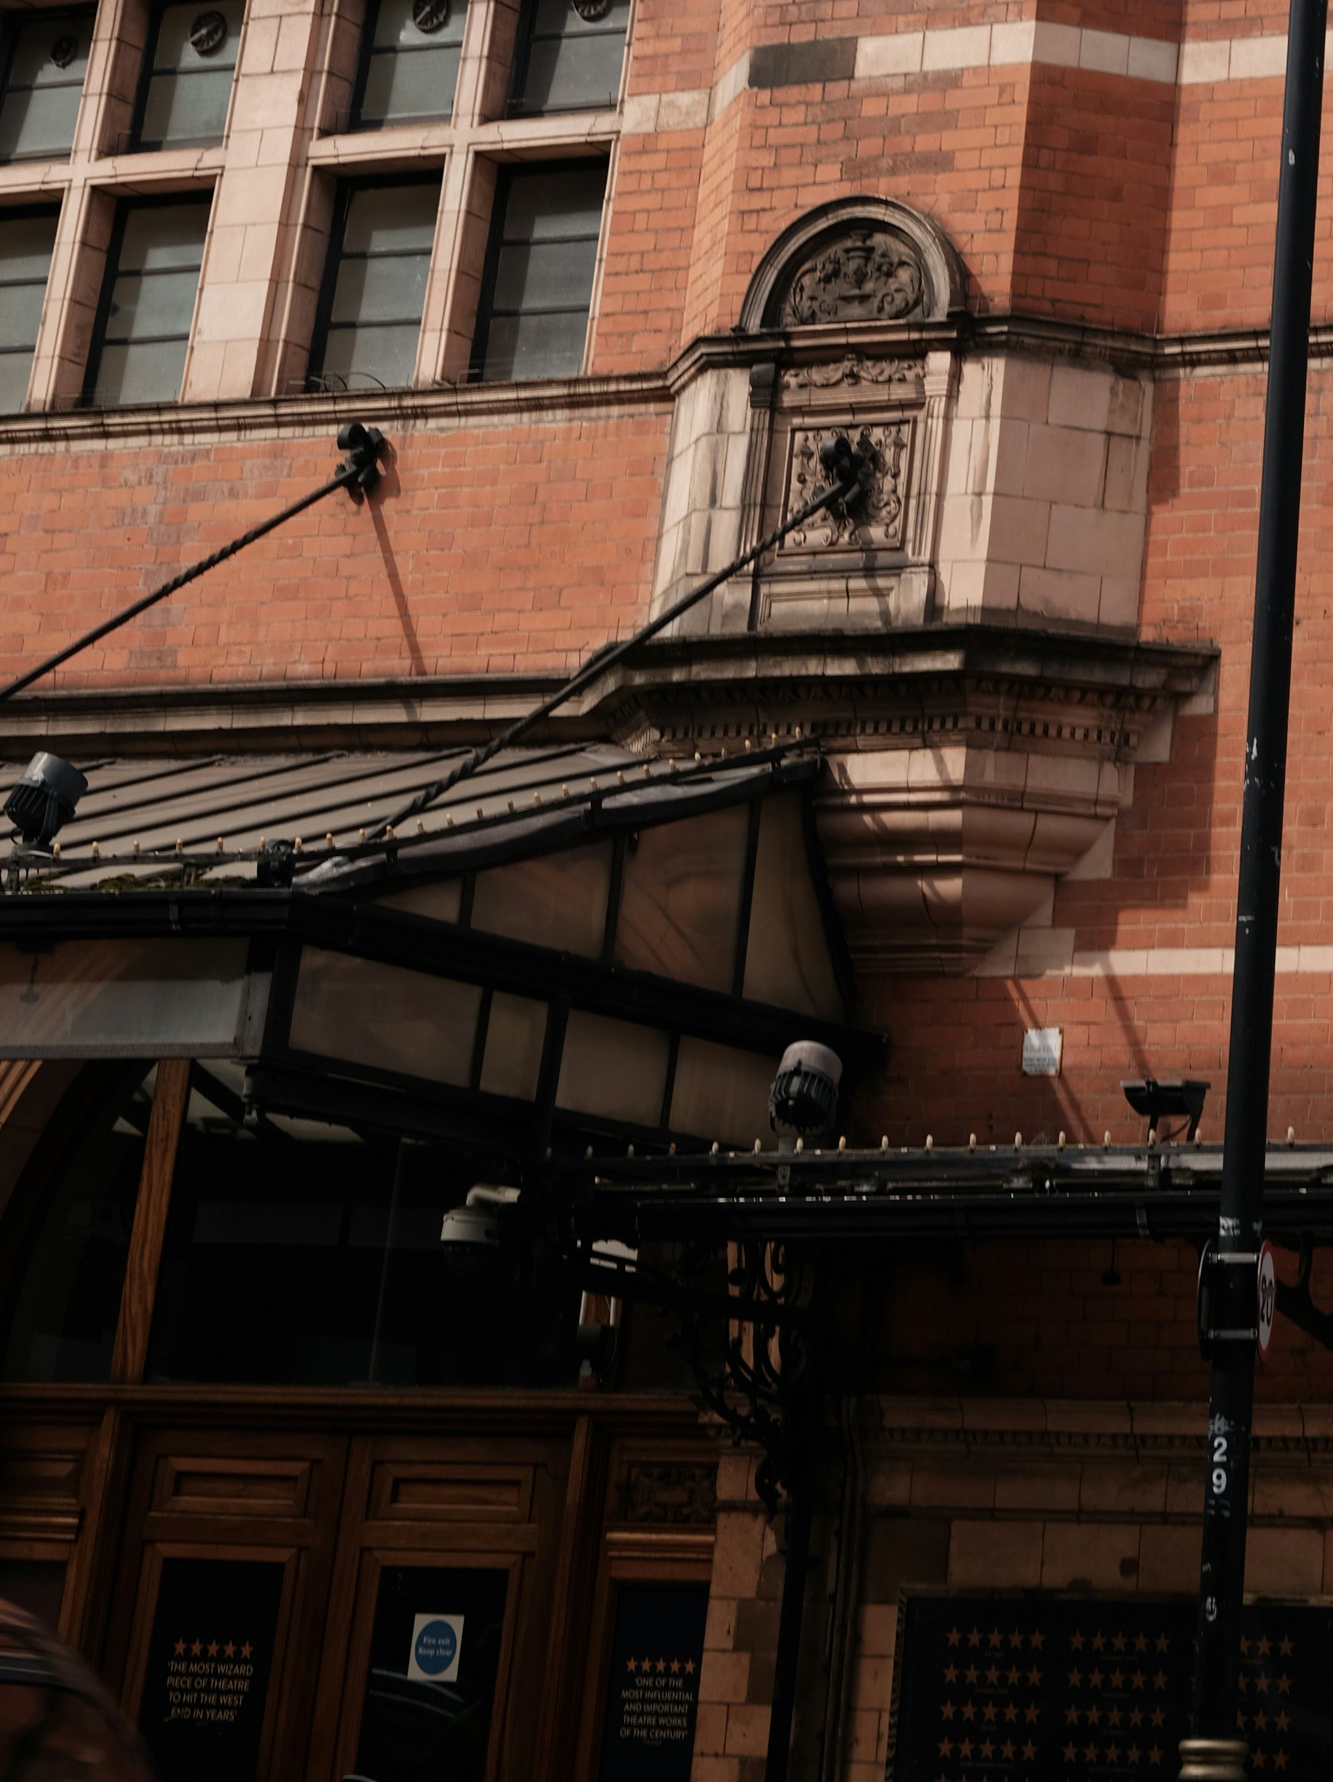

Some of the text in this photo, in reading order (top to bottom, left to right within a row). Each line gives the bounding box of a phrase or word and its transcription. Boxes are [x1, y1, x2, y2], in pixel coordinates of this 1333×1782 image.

[189, 1661, 215, 1675] MOST
[217, 1662, 254, 1677] WIZARD
[166, 1676, 250, 1693] PIECE OF THEATRE
[655, 1676, 667, 1688] OF
[669, 1677, 684, 1689] THE
[169, 1691, 244, 1708] TO HIT THE WEST
[621, 1688, 693, 1702] MOST INFLUENTIAL
[193, 1708, 203, 1721] IN
[623, 1701, 689, 1715] AND IMPORTANT
[659, 1716, 687, 1727] WORKS
[619, 1726, 631, 1738] OF
[633, 1727, 648, 1739] THE
